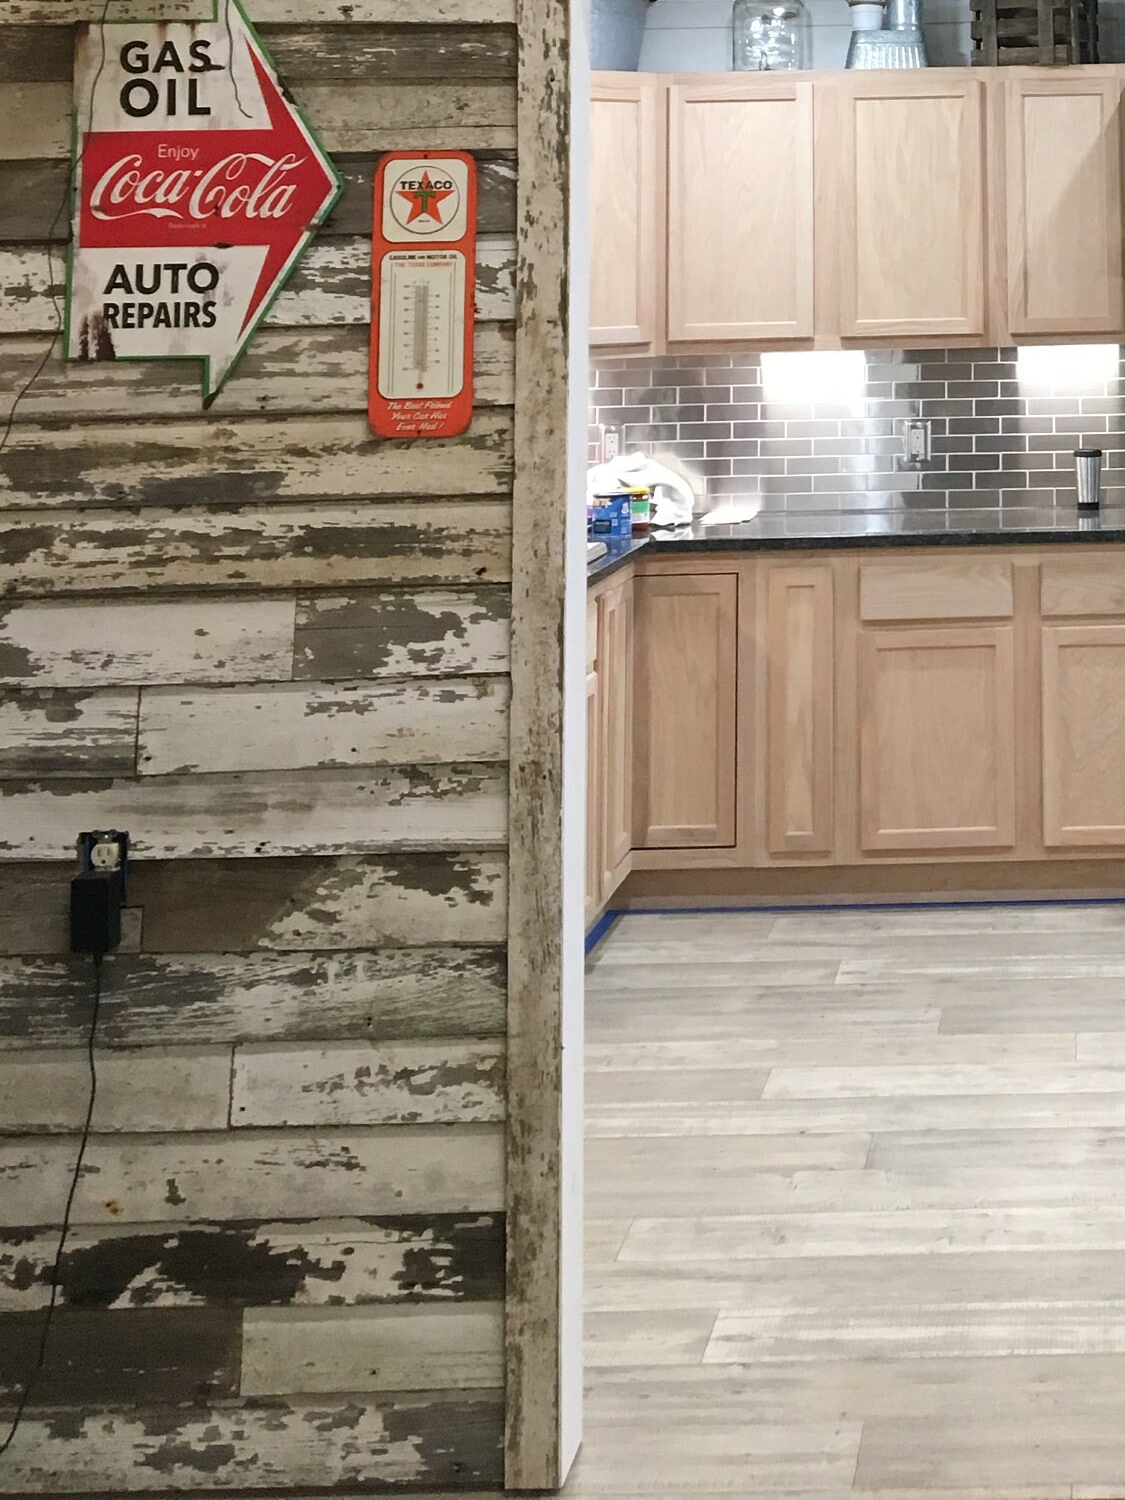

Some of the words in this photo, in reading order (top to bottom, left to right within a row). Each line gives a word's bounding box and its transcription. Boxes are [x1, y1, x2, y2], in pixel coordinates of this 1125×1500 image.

[119, 39, 213, 74] GAS
[119, 78, 211, 118] OIL
[157, 142, 200, 161] Enjoy
[90, 152, 307, 220] Coca-Cola
[400, 180, 453, 191] TEXACO
[103, 261, 220, 295] AUTO
[103, 300, 218, 329] REPAIRS
